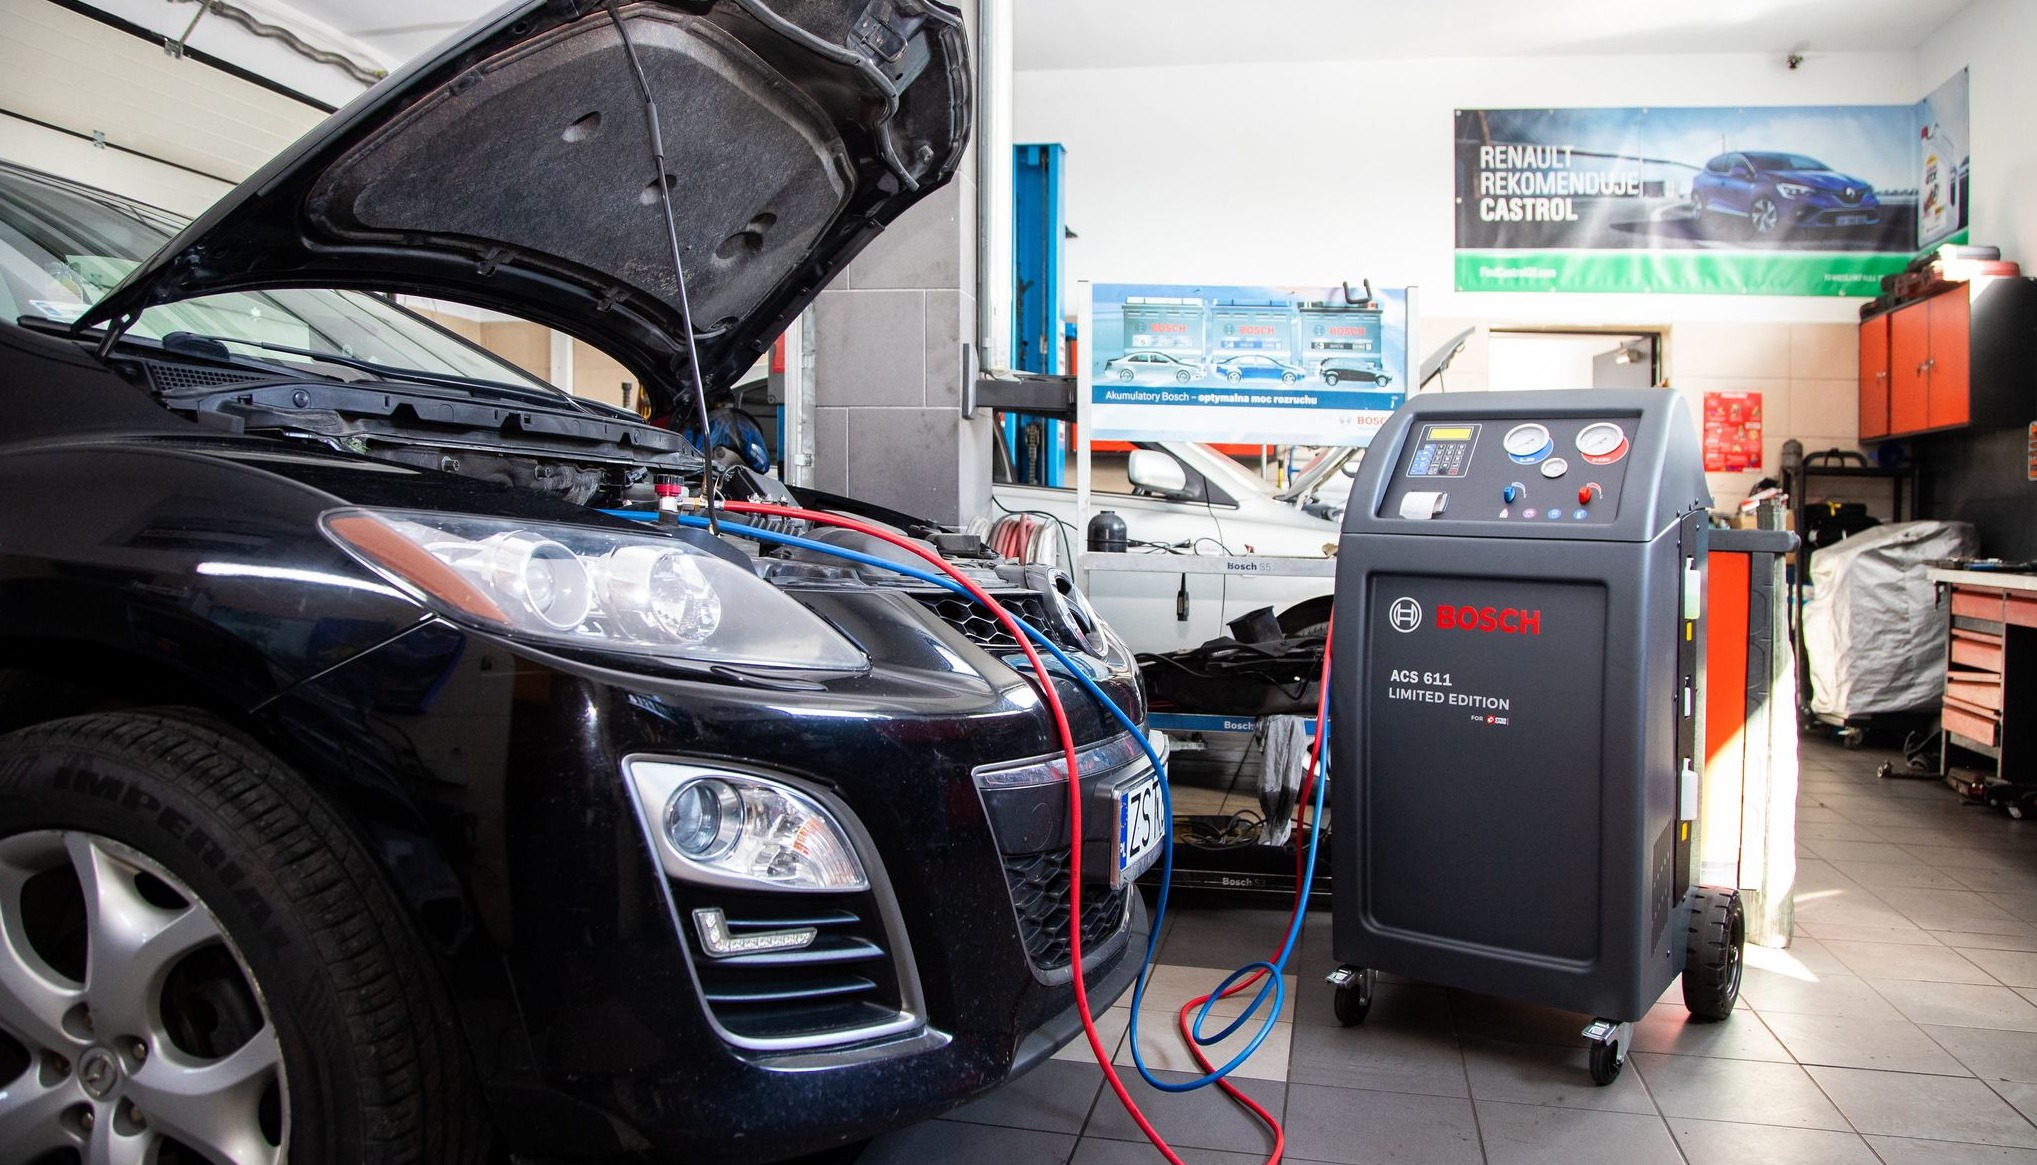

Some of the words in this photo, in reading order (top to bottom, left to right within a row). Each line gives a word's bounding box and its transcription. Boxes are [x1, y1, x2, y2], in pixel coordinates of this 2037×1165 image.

[1480, 145, 1574, 169] RENAULT
[1480, 171, 1639, 196] REKOMENDUJE
[1480, 197, 1579, 221] CASTROL
[1150, 323, 1186, 333] BOSCH
[1239, 326, 1275, 335] BOSCH
[1329, 327, 1366, 336] BOSCH
[1105, 390, 1160, 402] Akumulatory
[1162, 391, 1189, 402] Bosch
[1198, 393, 1250, 404] optymalna
[1251, 396, 1272, 404] moc
[1273, 395, 1318, 405] rozruchu
[1227, 561, 1257, 571] Bosch
[1436, 604, 1541, 635] BOSCH
[1390, 669, 1418, 684] ACS
[1423, 672, 1452, 687] 611
[1388, 687, 1445, 704] LIMITED
[1448, 693, 1510, 711] EDITION
[1470, 714, 1484, 722] FOR
[53, 765, 291, 955] IMPERIAL
[1222, 877, 1252, 887] Bosch
